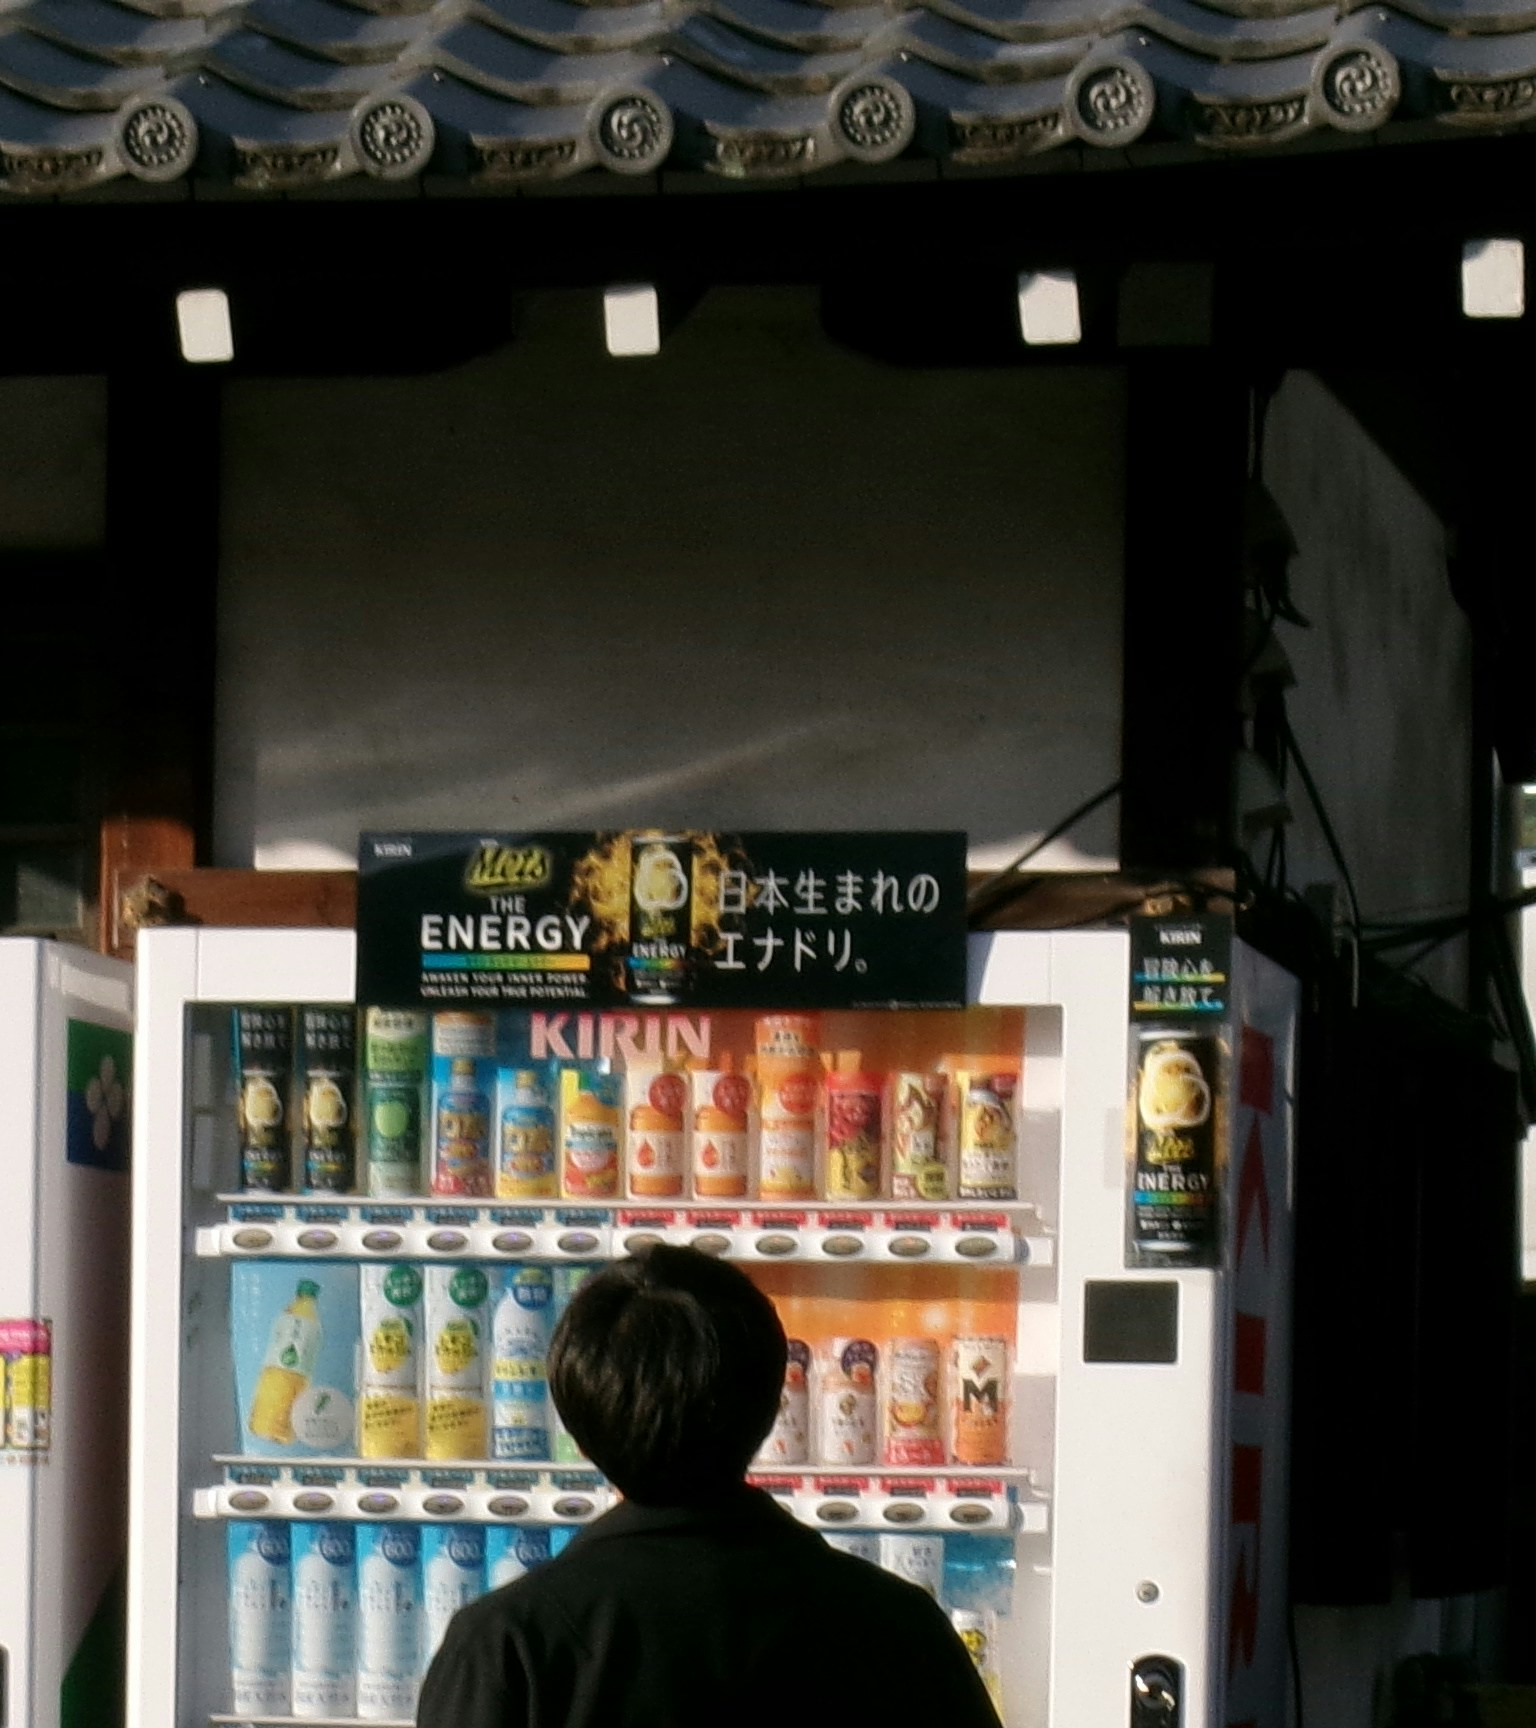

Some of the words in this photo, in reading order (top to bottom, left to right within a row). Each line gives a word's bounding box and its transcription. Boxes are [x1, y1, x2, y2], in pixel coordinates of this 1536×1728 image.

[374, 843, 412, 857] KIRIN
[718, 867, 941, 916] 日本生まれの
[490, 897, 526, 914] THE
[420, 914, 591, 950] ENERGY
[714, 926, 868, 974] エナドリ。
[471, 985, 499, 998] YOUR
[502, 985, 528, 998] TRUE
[530, 985, 586, 998] POTENTIAL
[472, 972, 503, 985] YOUR
[507, 972, 542, 985] INNER
[546, 972, 587, 985] POWER
[530, 1012, 712, 1059] KIRIN
